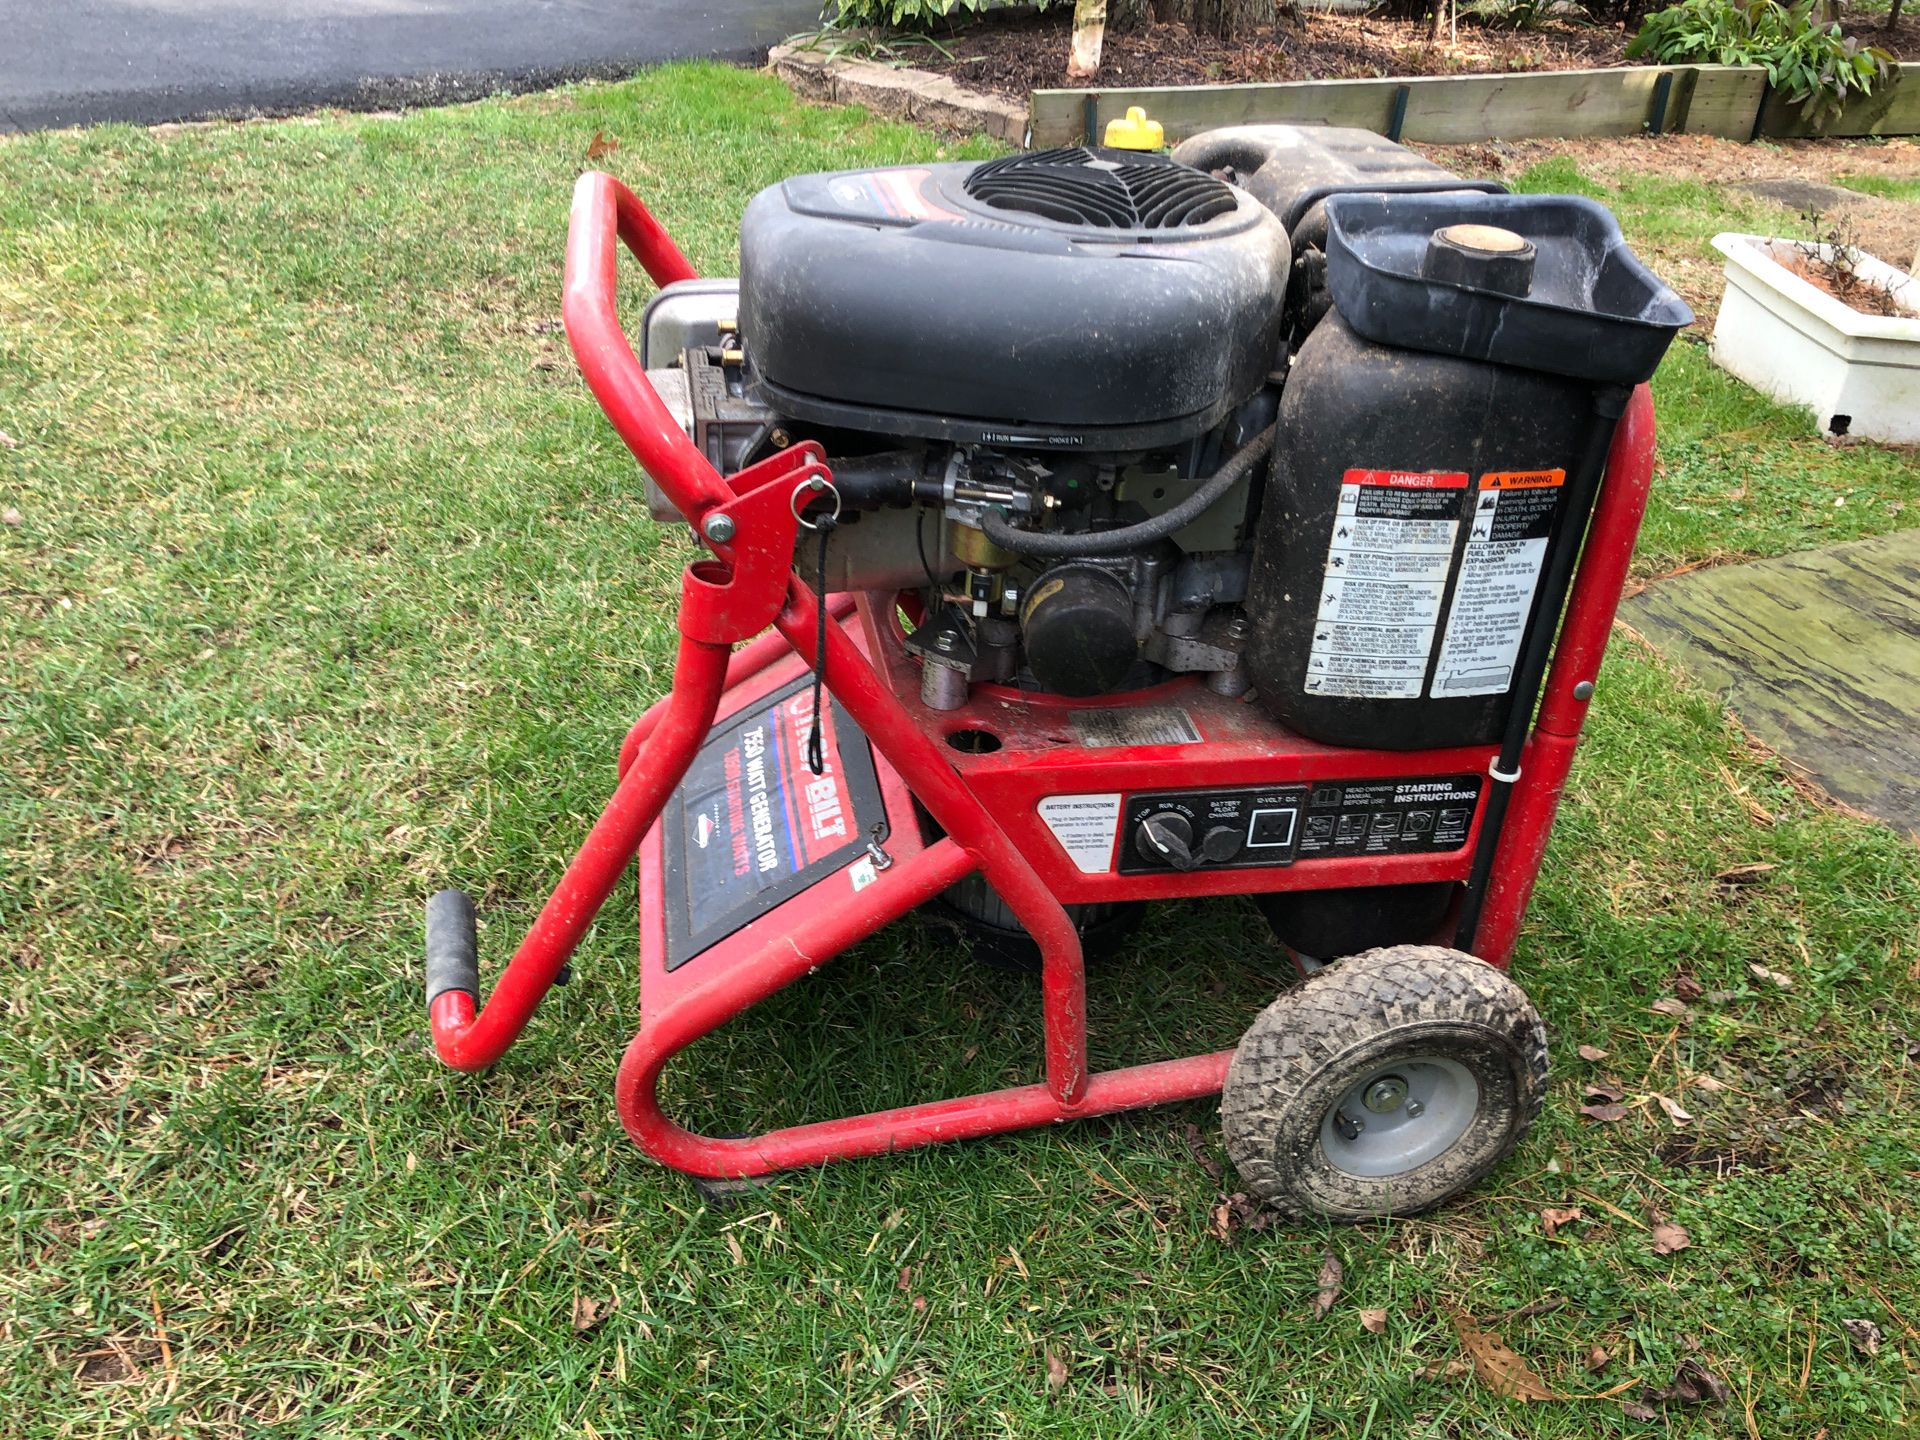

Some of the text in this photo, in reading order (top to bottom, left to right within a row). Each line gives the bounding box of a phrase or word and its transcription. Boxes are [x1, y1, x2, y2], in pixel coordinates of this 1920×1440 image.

[1048, 436, 1069, 444] CHOKE
[1389, 474, 1434, 486] DANGER
[1509, 475, 1553, 486] WARNING
[1495, 514, 1520, 522] INJURY
[1493, 523, 1529, 531] PROPERTY
[1395, 783, 1453, 794] STARTING
[743, 726, 778, 873] 7550 WATT GENERATOR
[1393, 791, 1477, 803] INSTRUCTIONS
[726, 779, 745, 834] STARTING
[1158, 802, 1174, 810] RUN
[1175, 804, 1195, 819] START
[1133, 808, 1151, 823] STOP
[731, 832, 751, 876] WATTS
